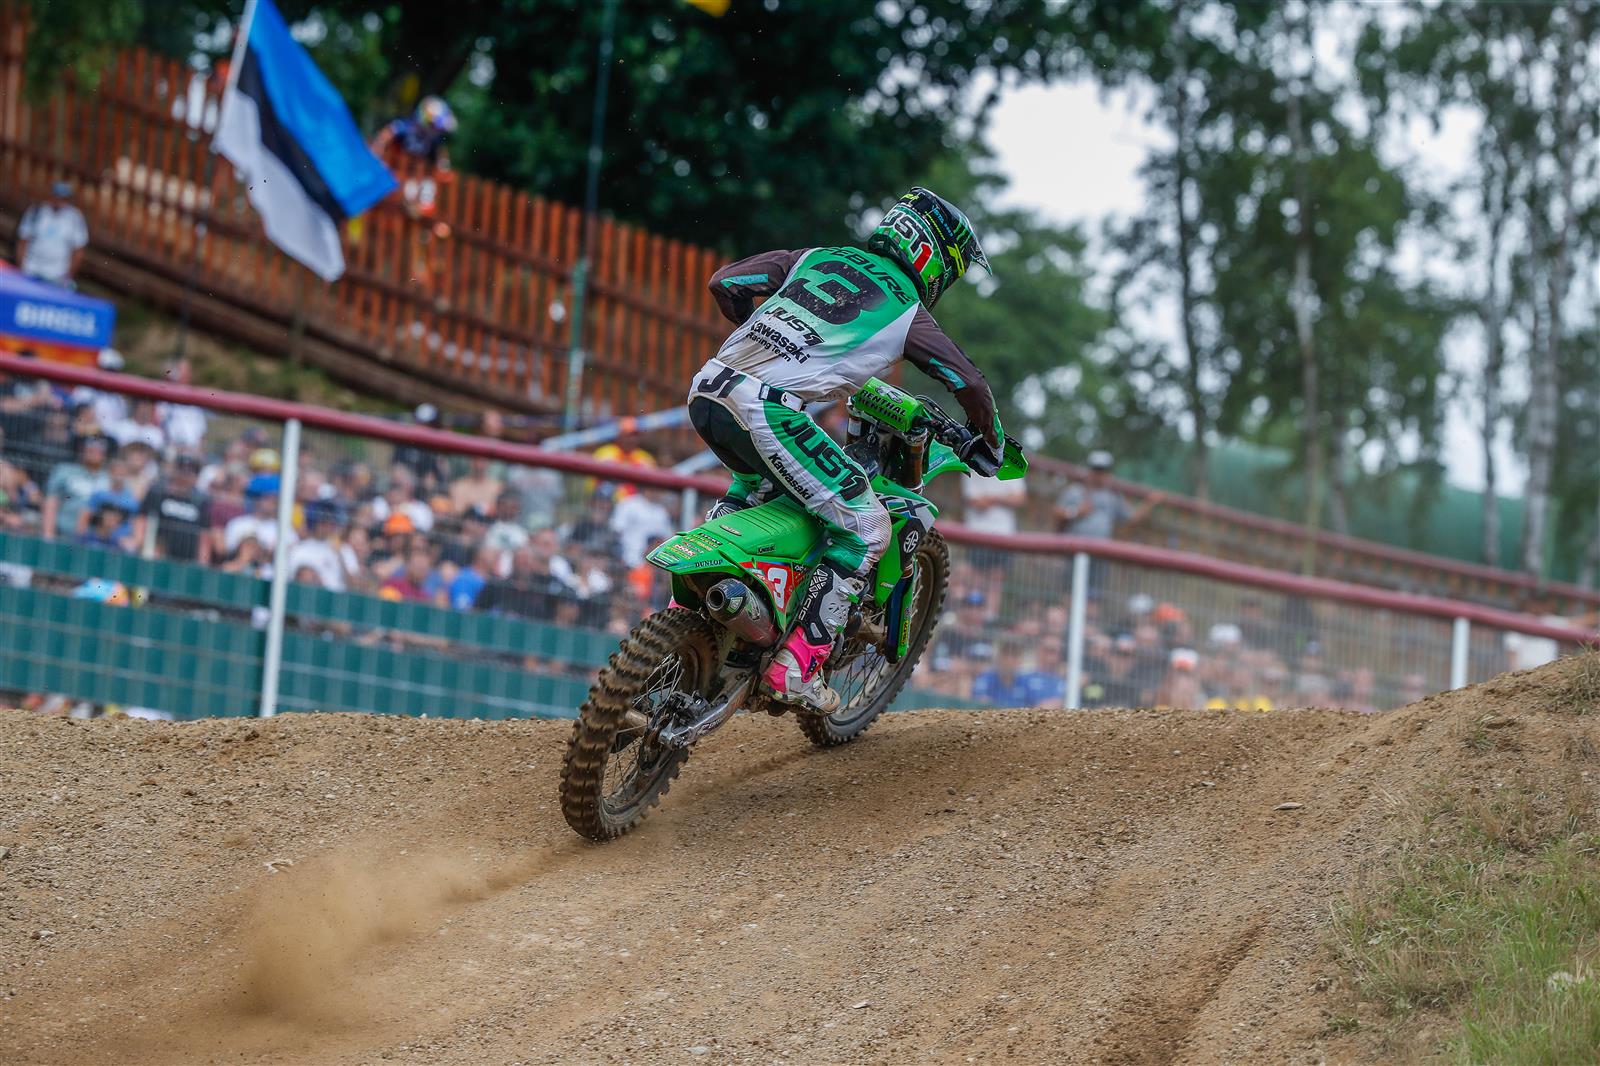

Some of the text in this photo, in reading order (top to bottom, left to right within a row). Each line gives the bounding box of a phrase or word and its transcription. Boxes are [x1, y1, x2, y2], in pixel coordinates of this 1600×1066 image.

[777, 260, 889, 325] 3
[861, 389, 907, 417] RENTHAL
[768, 452, 815, 501] Kawasaki
[780, 420, 868, 502] JUST1
[694, 559, 724, 568] DUNLOP
[767, 567, 789, 609] 3
